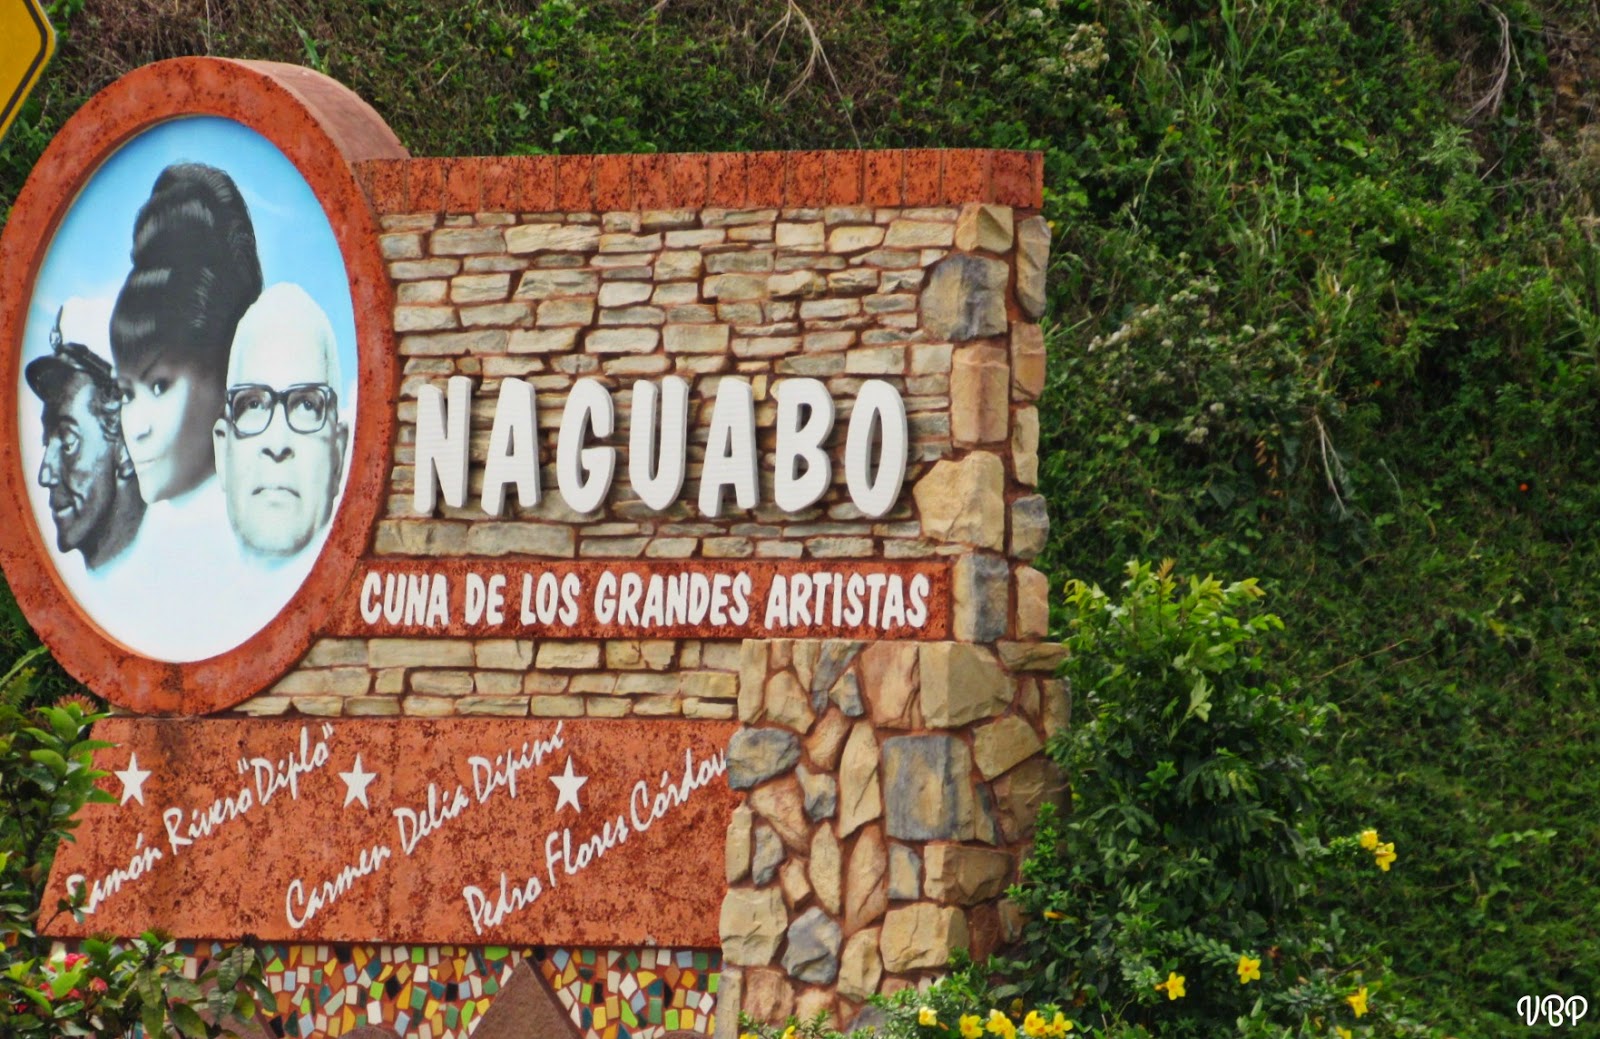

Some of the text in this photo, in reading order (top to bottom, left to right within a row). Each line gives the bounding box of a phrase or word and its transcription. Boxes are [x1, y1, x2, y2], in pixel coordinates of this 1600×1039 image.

[413, 375, 909, 518] NAGUABO
[360, 570, 930, 630] CUNA DE LOS GRANDES ARTISTAS
[286, 845, 391, 929] Carmen
[392, 783, 470, 856] Delia
[462, 872, 543, 936] Pedro
[545, 815, 629, 888] Flores
